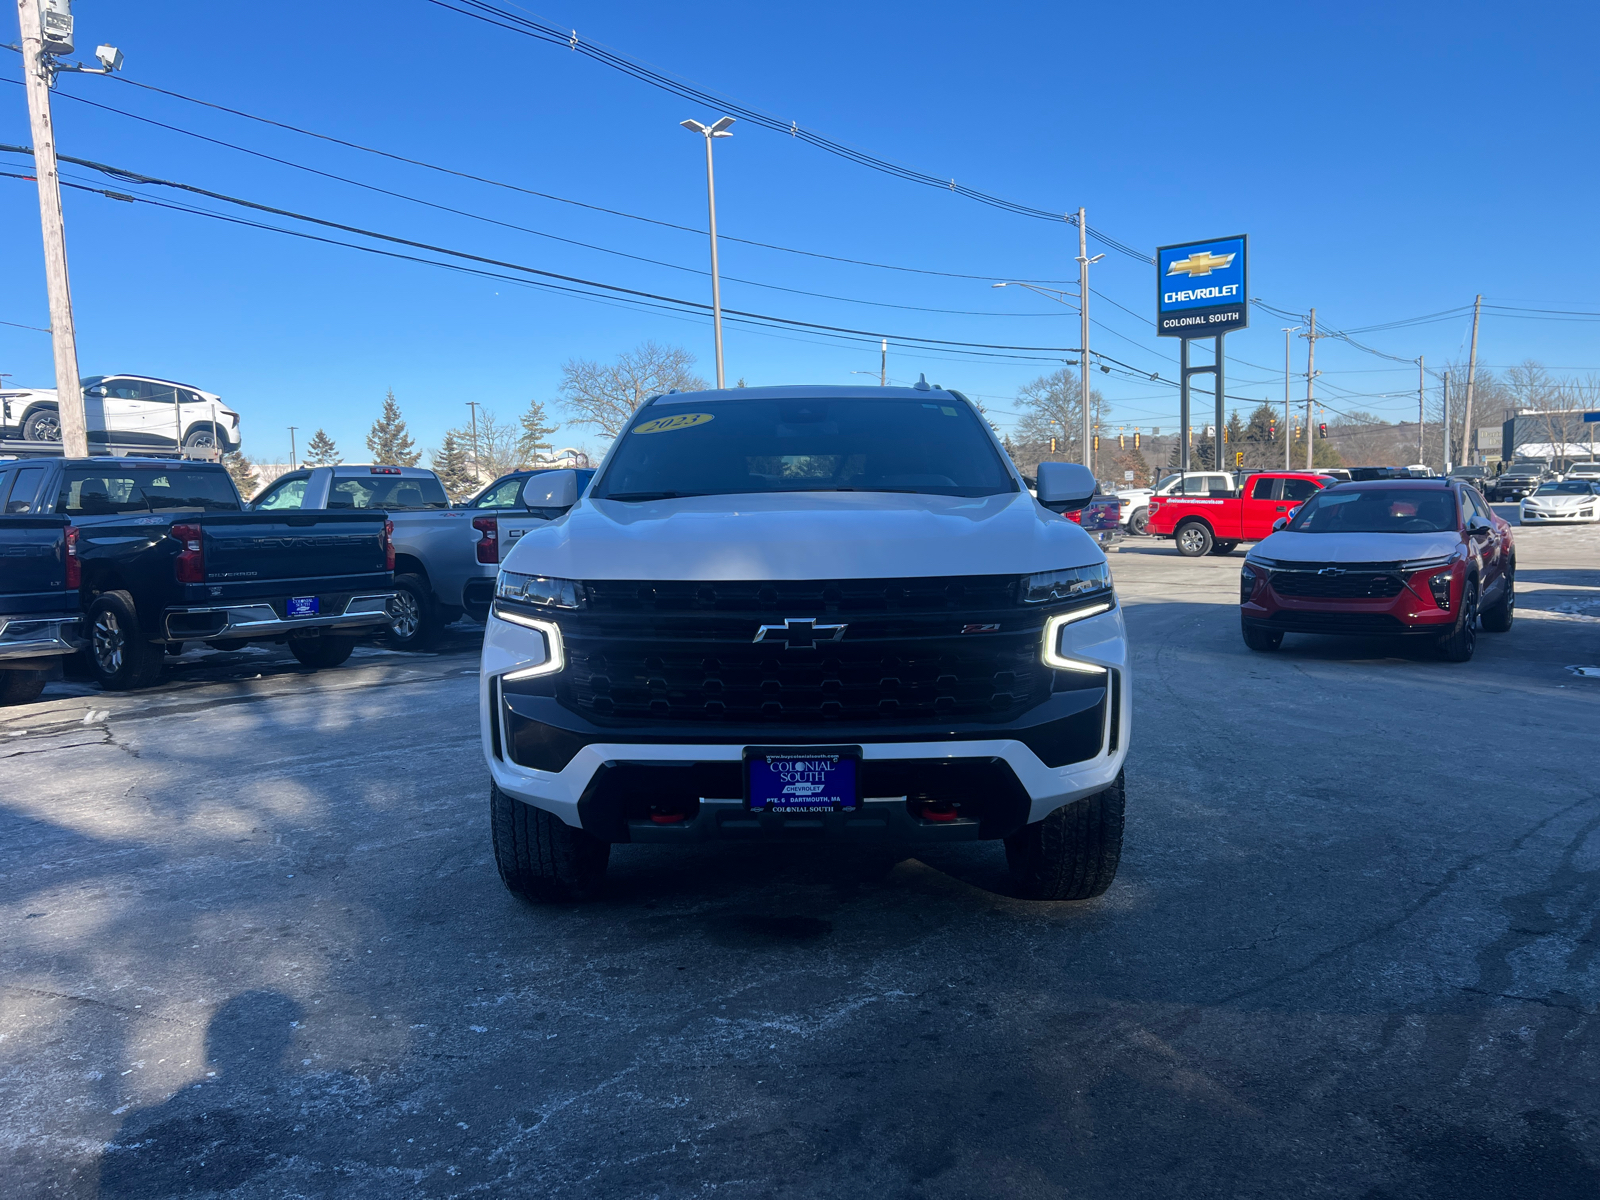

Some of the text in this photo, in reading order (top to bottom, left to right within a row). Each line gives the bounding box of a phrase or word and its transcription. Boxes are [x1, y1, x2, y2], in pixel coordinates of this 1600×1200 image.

[1164, 284, 1239, 303] CHEVROLET
[1163, 312, 1239, 328] COLONIAL SOUTH
[645, 414, 701, 432] 2023
[770, 761, 835, 772] COLONIAL
[780, 772, 825, 782] SOUTH
